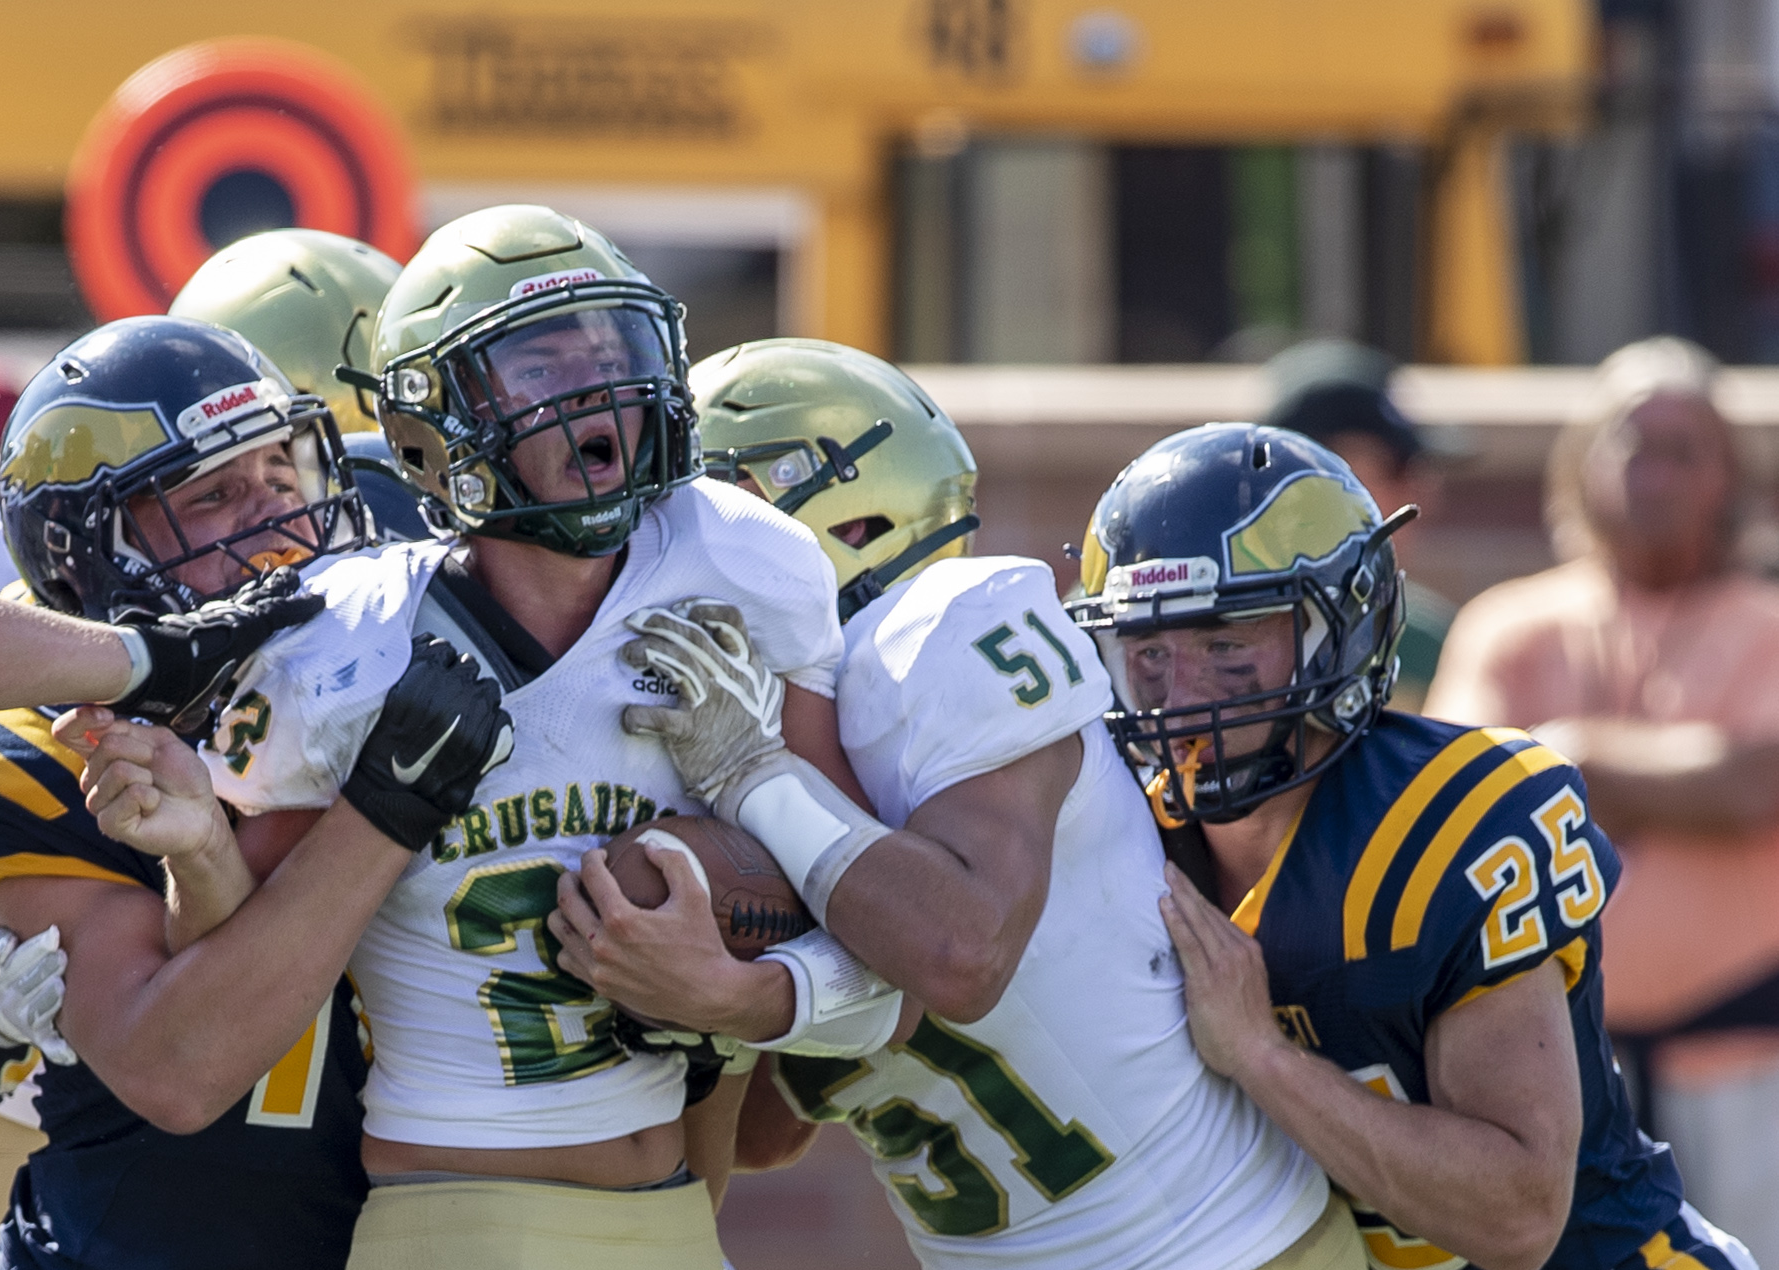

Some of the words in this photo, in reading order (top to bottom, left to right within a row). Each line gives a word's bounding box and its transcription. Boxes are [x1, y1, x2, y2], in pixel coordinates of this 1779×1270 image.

[201, 386, 258, 419] Riddell
[581, 506, 622, 528] Riddell
[1131, 564, 1189, 587] Riddell
[971, 607, 1085, 711] 51
[1464, 783, 1607, 971] 25
[443, 856, 632, 1087] 2
[772, 1008, 1117, 1237] 51
